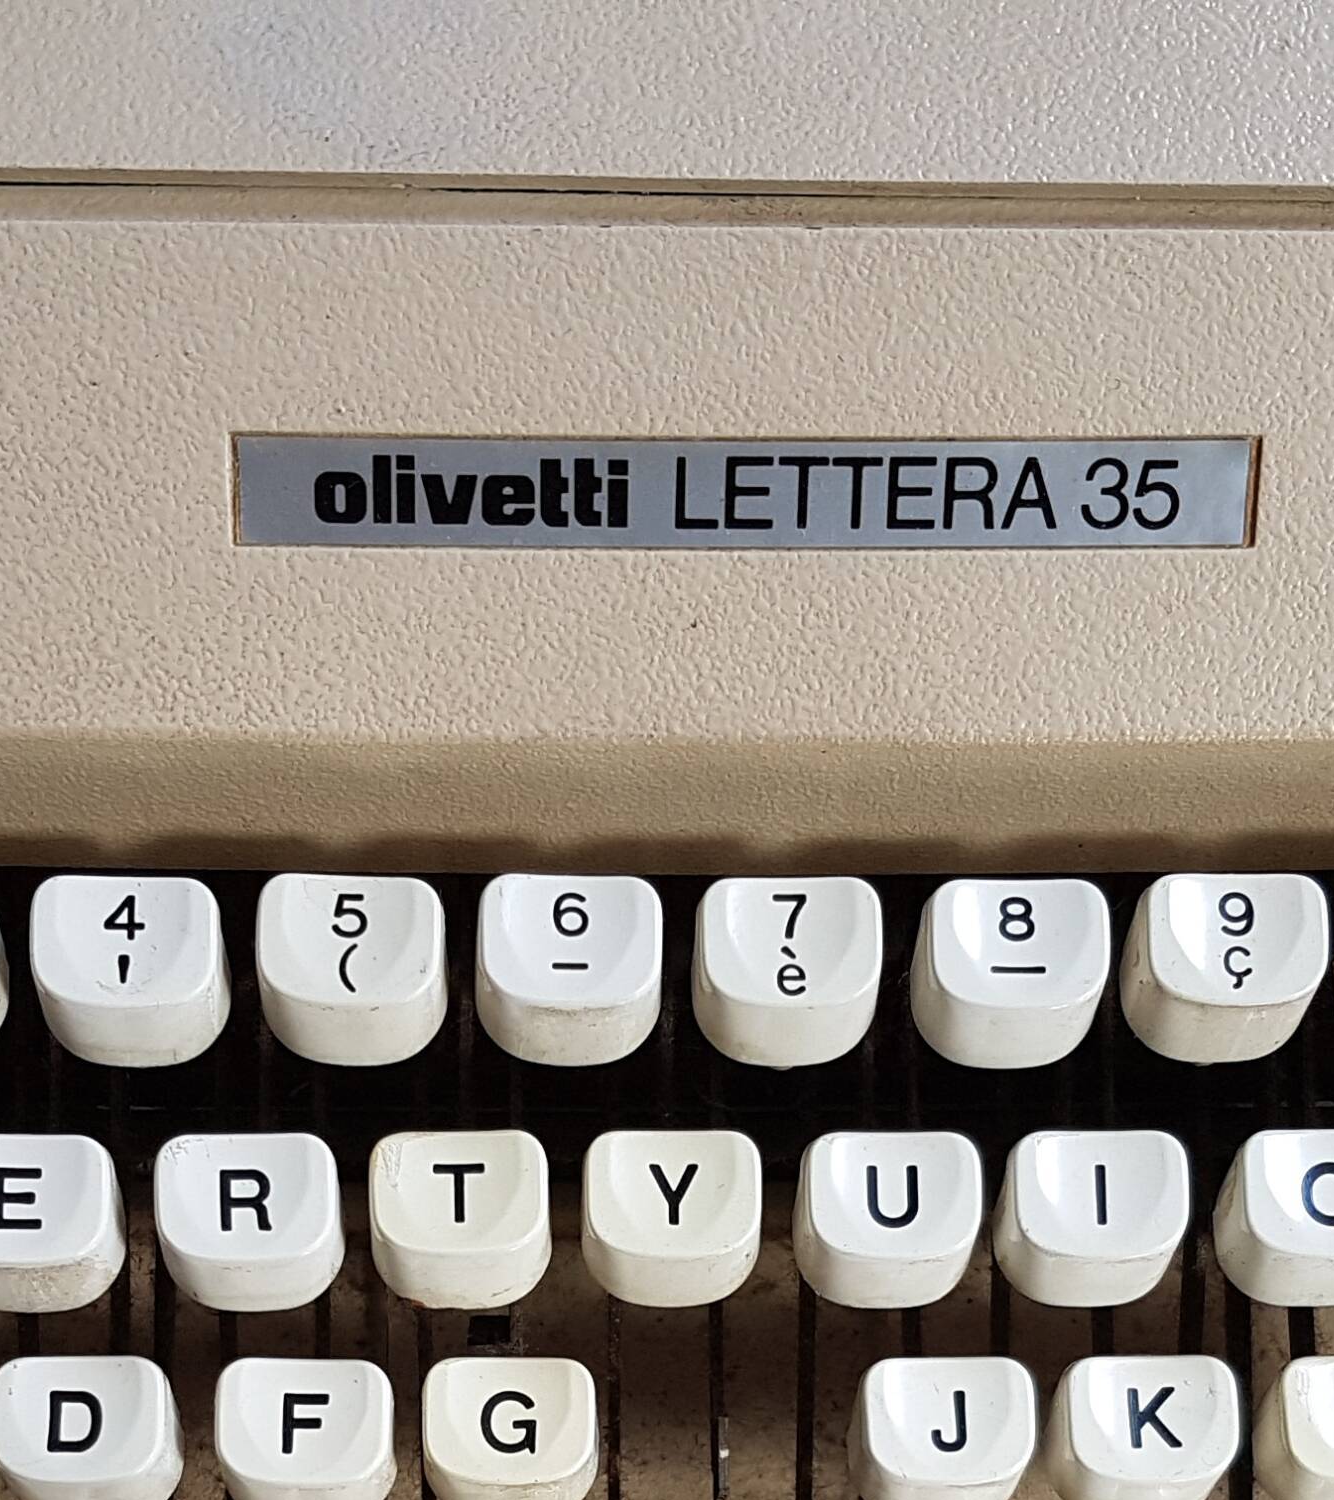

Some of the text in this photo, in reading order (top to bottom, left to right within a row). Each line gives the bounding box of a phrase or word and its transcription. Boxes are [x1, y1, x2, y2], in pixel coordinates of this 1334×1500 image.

[313, 454, 1180, 531] olivetti LETTERA 35
[103, 894, 146, 941] 4
[331, 893, 368, 939] 5
[552, 892, 589, 937] 6
[772, 893, 807, 939] 7
[998, 896, 1035, 942] 8
[1218, 891, 1255, 937] 9
[338, 943, 358, 993] (
[776, 945, 807, 997] è
[1223, 945, 1253, 990] ç
[219, 1169, 273, 1232] R
[432, 1162, 485, 1224] T
[648, 1163, 699, 1226] Y
[866, 1164, 919, 1229] U
[1094, 1164, 1108, 1226] I
[46, 1390, 103, 1453] D
[281, 1392, 330, 1455] F
[480, 1390, 537, 1455] G
[931, 1390, 968, 1453] J
[1127, 1386, 1183, 1449] K
